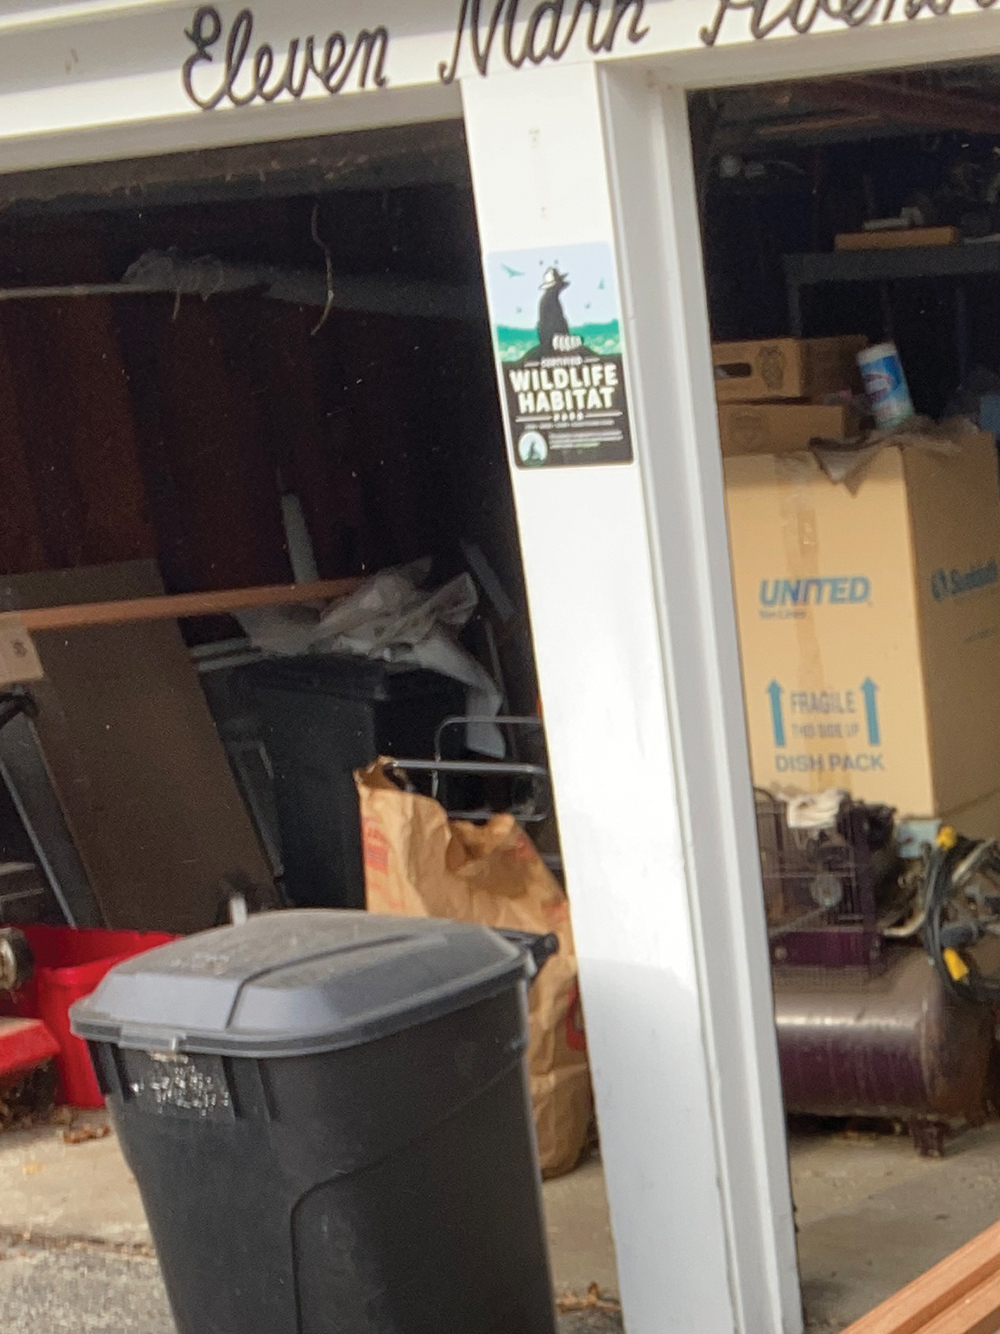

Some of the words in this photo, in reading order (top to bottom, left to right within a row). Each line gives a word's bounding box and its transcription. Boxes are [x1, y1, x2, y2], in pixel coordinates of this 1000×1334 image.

[181, 5, 389, 110] Eleven
[509, 362, 619, 393] WILDLIFE
[518, 386, 615, 414] HABITAT
[759, 576, 871, 607] UNITED
[790, 690, 855, 714] FRAGILE
[775, 753, 825, 773] DISH
[828, 752, 885, 772] PACK
